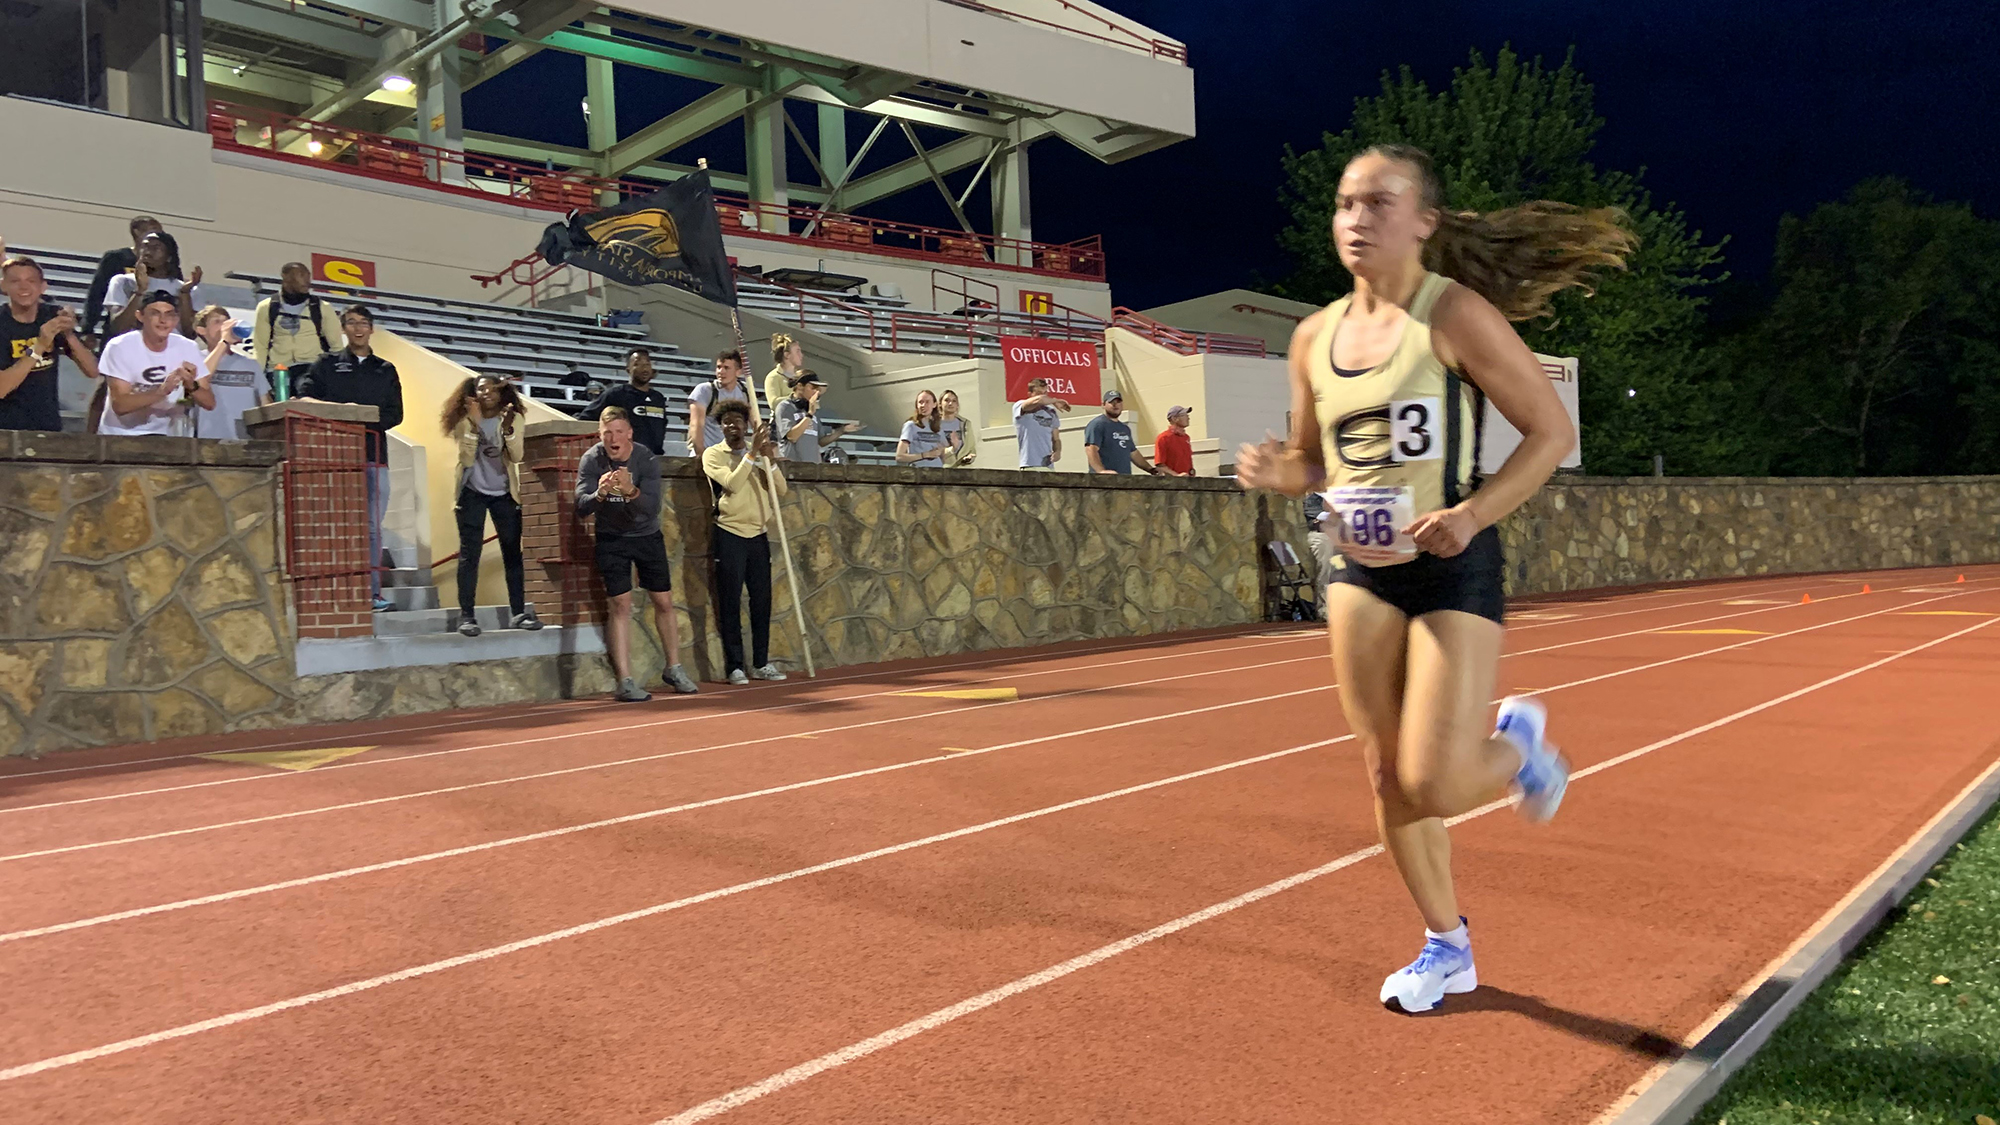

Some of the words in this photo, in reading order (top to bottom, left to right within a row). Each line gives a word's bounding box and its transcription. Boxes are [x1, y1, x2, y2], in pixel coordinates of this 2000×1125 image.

[1010, 346, 1092, 367] OFFICIALS
[1044, 377, 1077, 395] REA
[1398, 403, 1431, 458] 3
